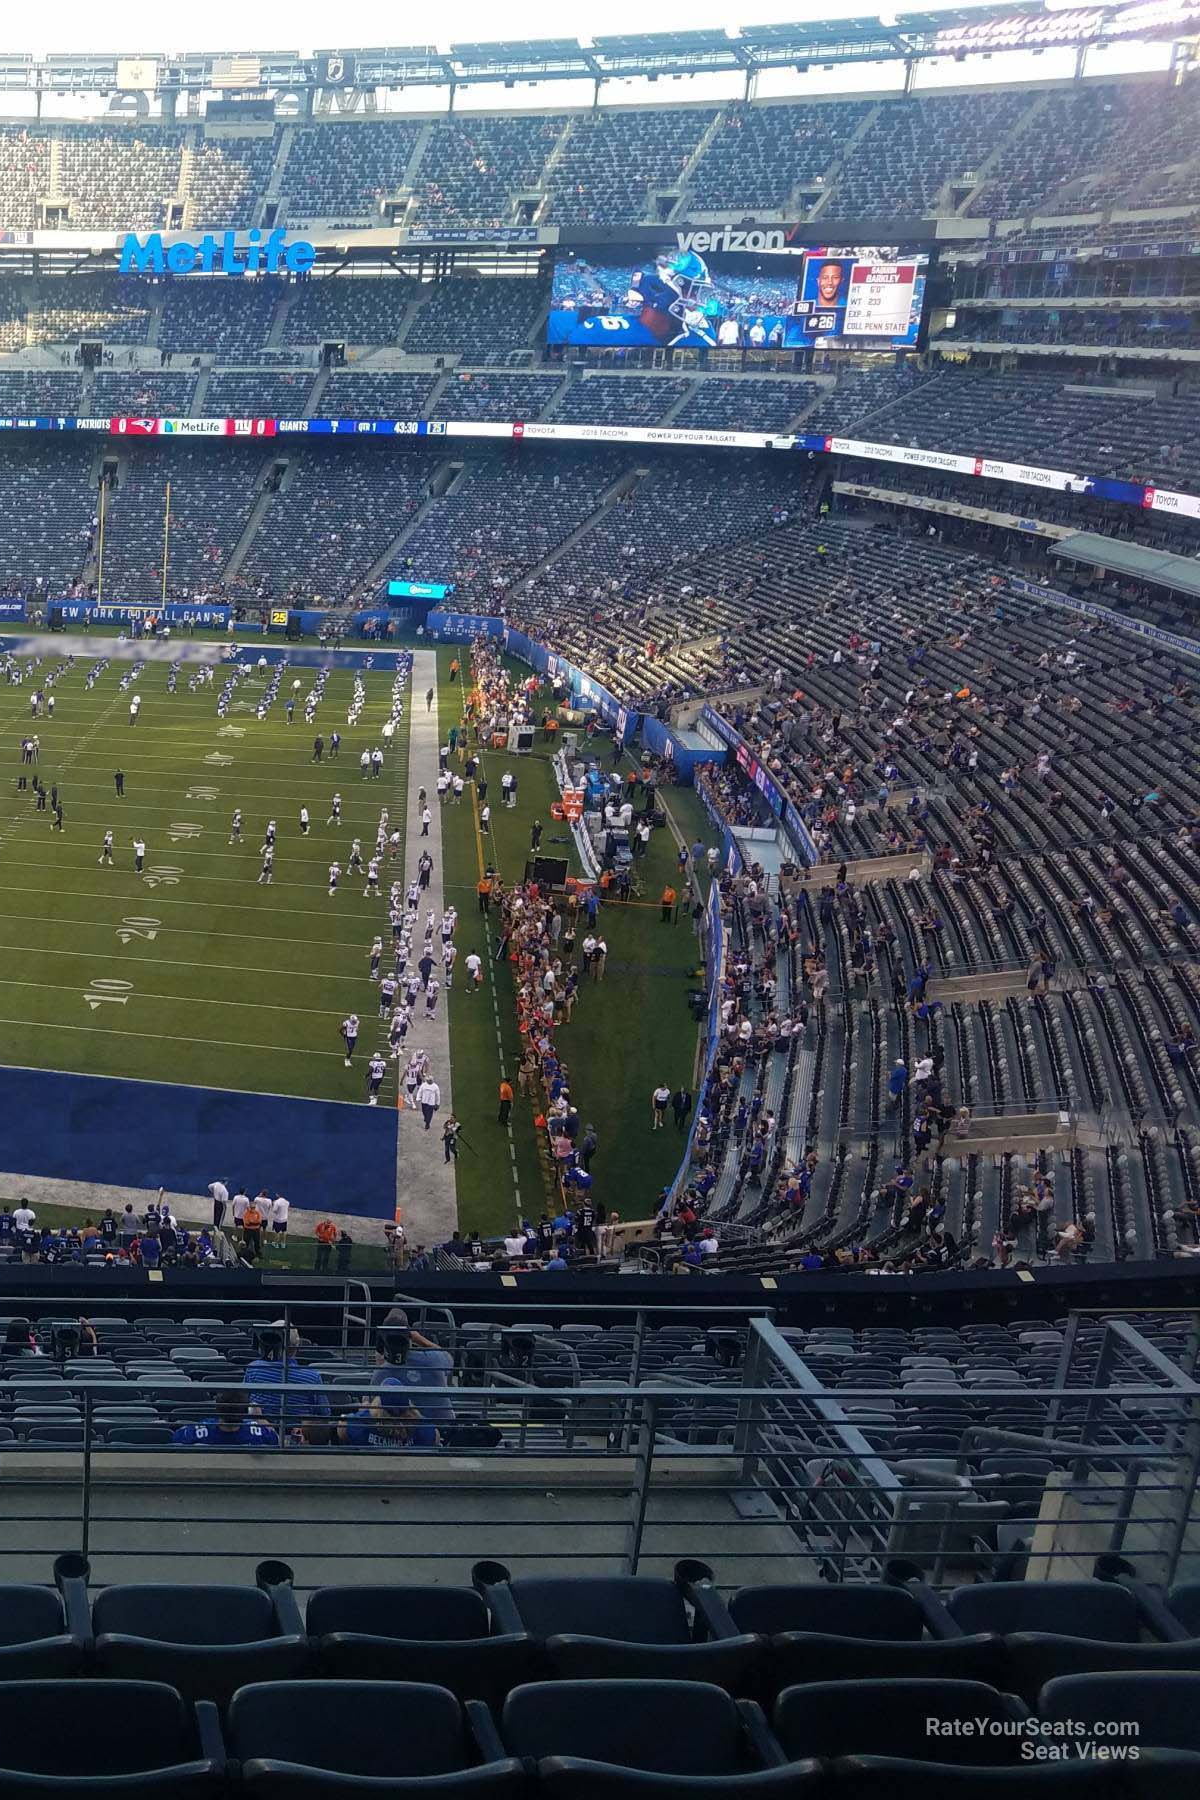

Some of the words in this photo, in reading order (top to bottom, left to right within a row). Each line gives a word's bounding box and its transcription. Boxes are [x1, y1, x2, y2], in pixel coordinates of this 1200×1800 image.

[677, 225, 784, 252] verizon
[119, 227, 316, 273] MetLife
[866, 275, 901, 284] BARKLEY
[885, 323, 906, 331] STATE
[77, 419, 111, 429] PATRIOTS
[119, 419, 126, 432] 0
[181, 422, 220, 432] MetLife
[257, 420, 265, 434] 0
[279, 421, 309, 431] GIANTS
[394, 422, 418, 434] 43:30
[705, 434, 736, 442] TAILGATE
[985, 464, 1004, 475] TOYOTA
[1156, 495, 1178, 507] TOYOTA
[62, 607, 78, 617] EW
[85, 607, 113, 618] YORK
[120, 608, 177, 621] FOOTBALL
[273, 612, 286, 623] 25
[115, 917, 162, 940] 20
[83, 978, 134, 1006] 10
[584, 1216, 592, 1226] 12
[65, 1347, 72, 1358] 5
[267, 1349, 274, 1360] 4
[395, 1353, 402, 1364] 3
[522, 1355, 529, 1366] 2
